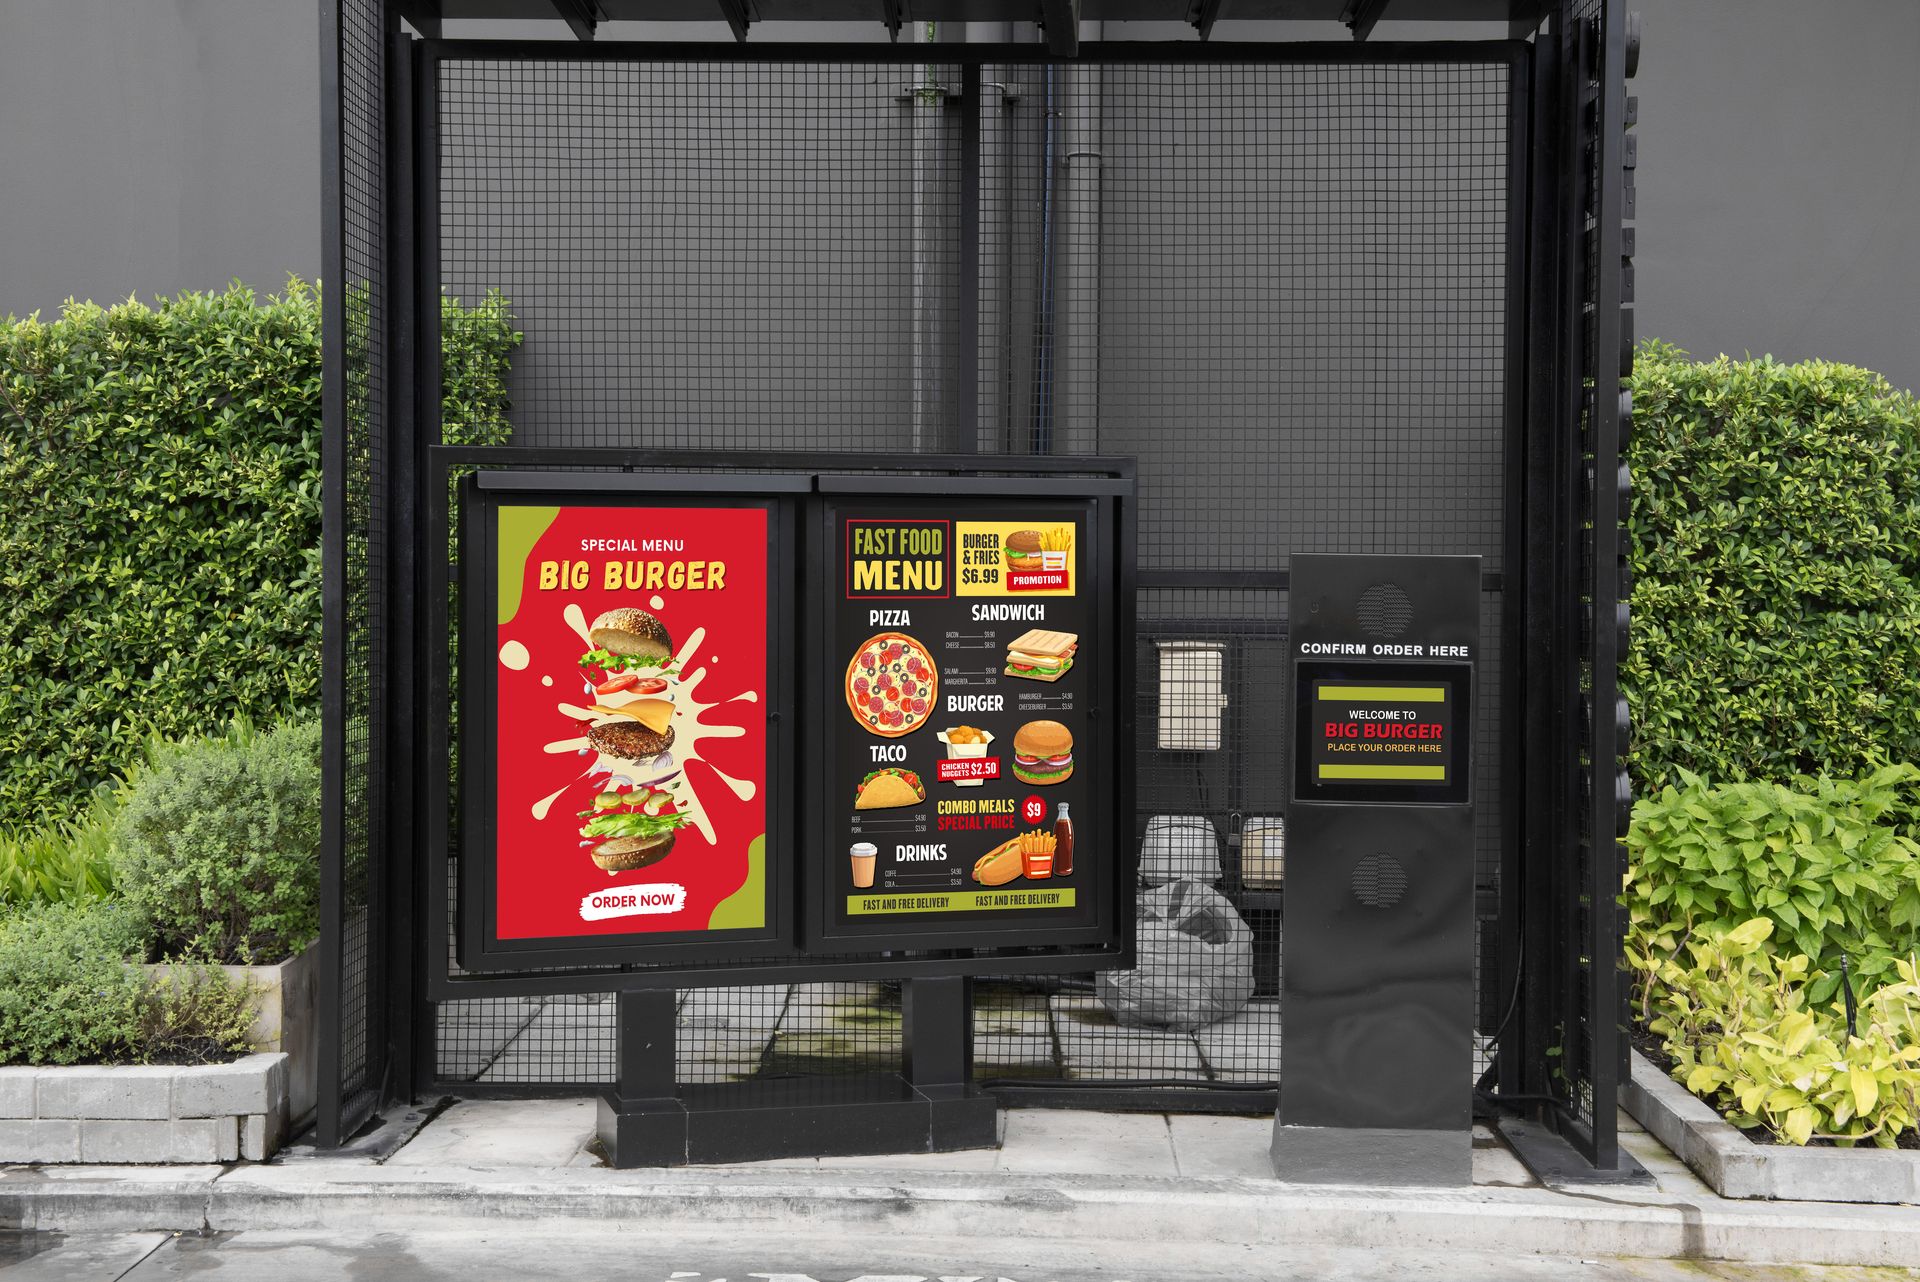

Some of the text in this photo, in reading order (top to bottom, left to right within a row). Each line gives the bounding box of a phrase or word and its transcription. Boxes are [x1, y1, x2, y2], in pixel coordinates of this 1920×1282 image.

[581, 539, 684, 551] SPECIAL MENU
[855, 528, 942, 555] FAST FOOD
[963, 533, 999, 549] BURGER
[963, 550, 999, 565] & FRIES
[539, 560, 727, 590] BIG BURGER
[853, 560, 943, 590] MENU
[962, 568, 999, 585] $6.99
[1013, 575, 1062, 585] PROMOTION
[869, 610, 911, 626] PIZZA
[971, 604, 1045, 621] SANDWICH
[1301, 643, 1468, 656] CONFIRM ORDER HERE
[947, 695, 1004, 712] BURGER
[1349, 710, 1416, 720] WELCOME TO
[1325, 723, 1444, 740] BIG BURGER
[870, 745, 907, 762] TACO
[1327, 743, 1442, 753] PLACE YOUR ORDER HERE
[942, 763, 970, 771] CHICKEN
[970, 762, 996, 776] $2.50
[938, 799, 1014, 814] COMBO MEALS
[1026, 802, 1041, 818] $9
[938, 814, 1014, 831] SPECIAL PRICE
[896, 844, 947, 862] DRINKS
[592, 893, 675, 908] ORDER NOW
[863, 897, 950, 910] FAST AND FREE DELIVERY
[976, 894, 1060, 906] FAST AND FREE DELIVERY
